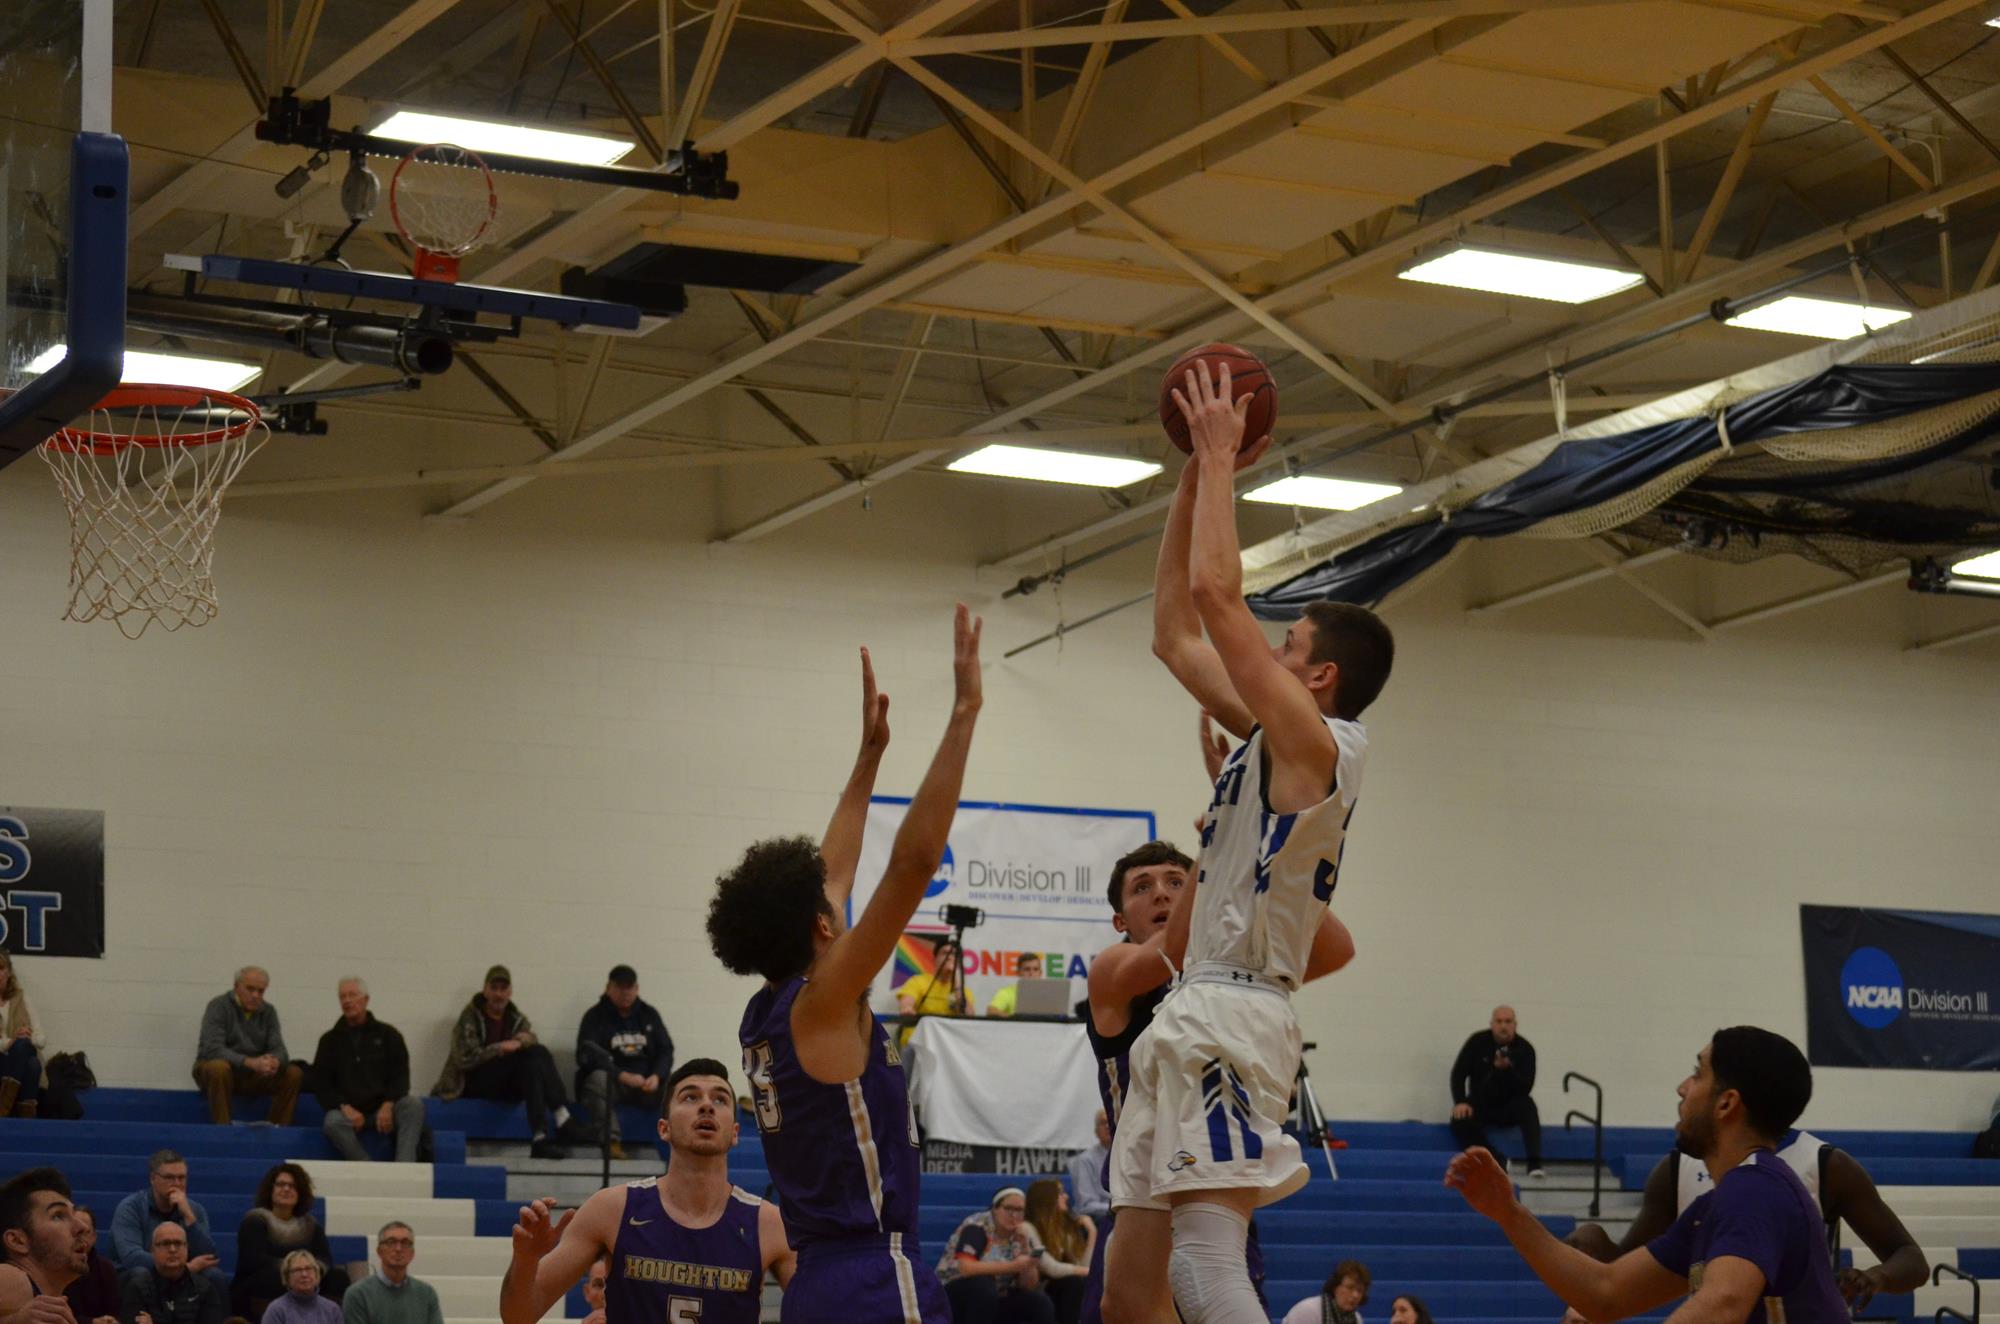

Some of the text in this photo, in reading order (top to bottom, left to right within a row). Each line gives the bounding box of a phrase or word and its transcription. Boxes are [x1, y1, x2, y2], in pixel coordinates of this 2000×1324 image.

[969, 861, 1064, 890] Division
[1075, 867, 1090, 891] III
[1848, 986, 1987, 1011] NCAA Division III
[926, 1142, 974, 1159] MEDIA
[926, 1160, 964, 1174] DECK
[624, 1255, 752, 1291] HOUGHTON
